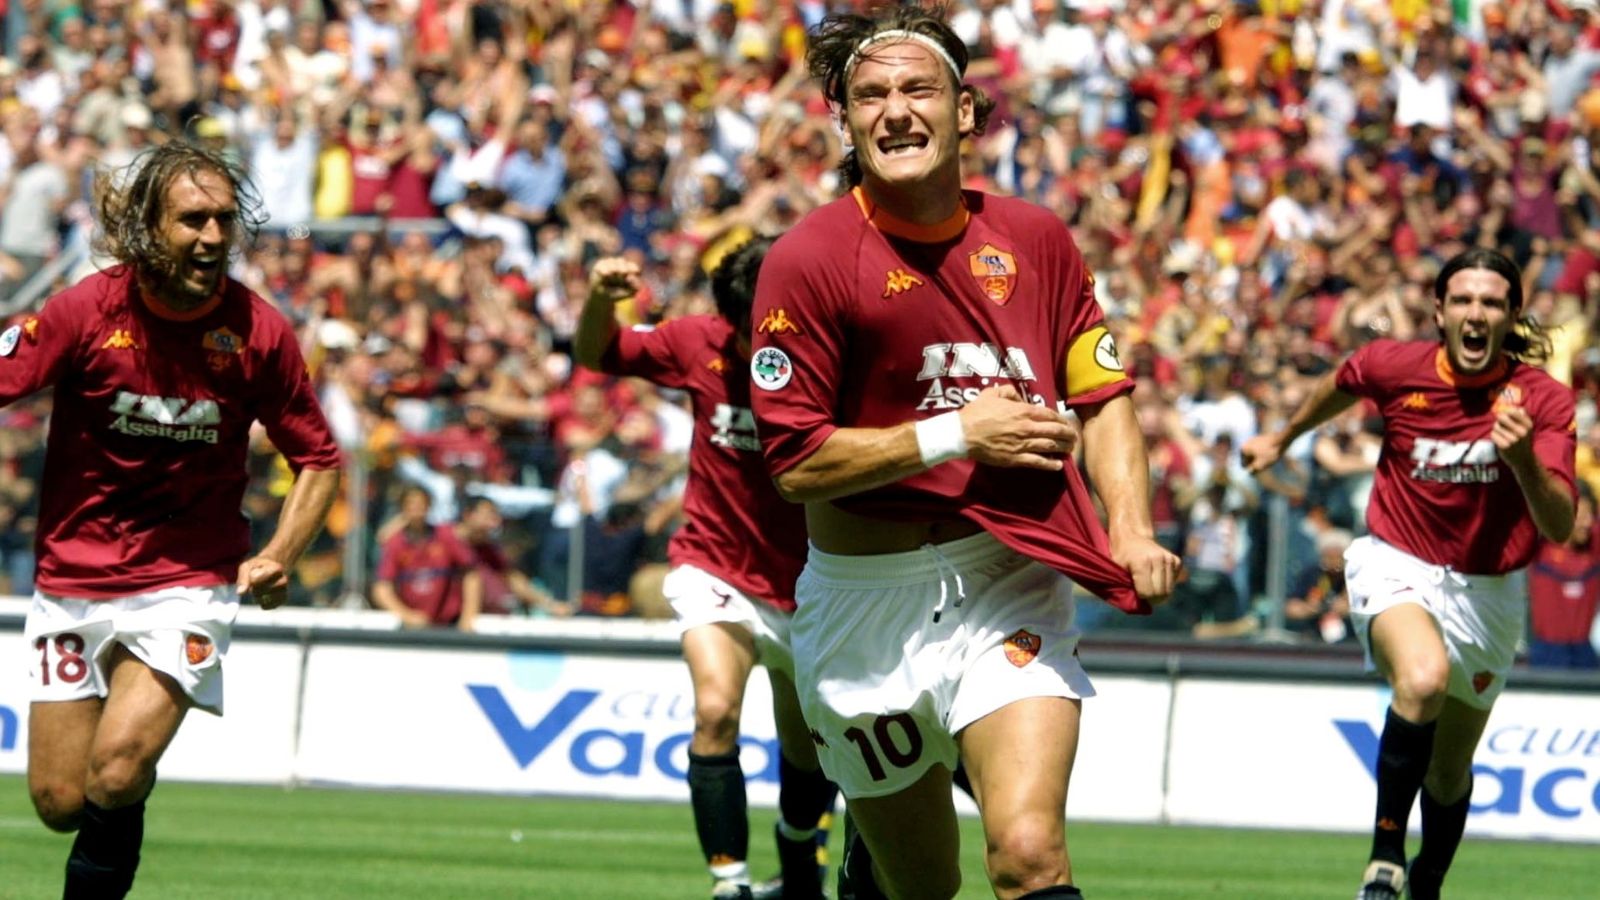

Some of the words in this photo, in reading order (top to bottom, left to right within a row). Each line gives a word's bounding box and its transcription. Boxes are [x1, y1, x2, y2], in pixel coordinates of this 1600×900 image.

[916, 342, 1037, 381] INA
[109, 390, 221, 425] INA
[109, 415, 219, 444] Assitalia
[35, 633, 87, 686] 18
[844, 711, 924, 782] 10
